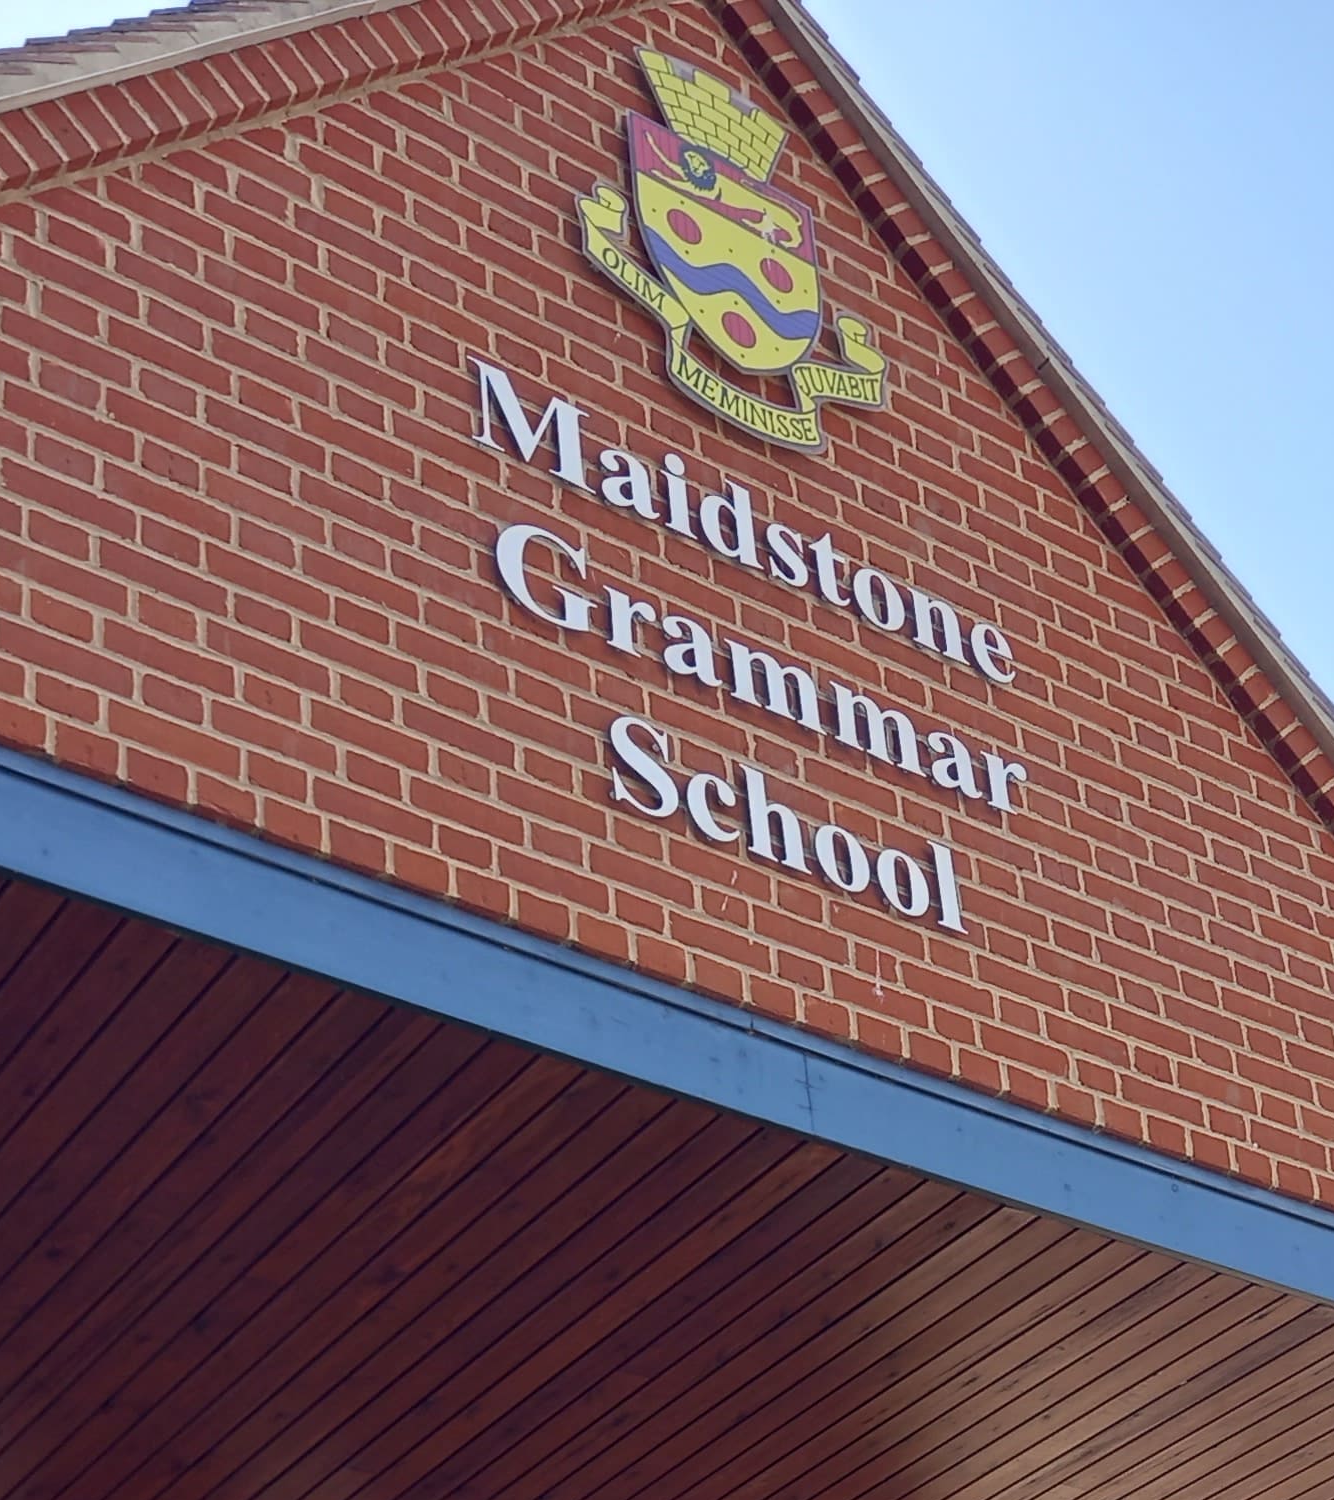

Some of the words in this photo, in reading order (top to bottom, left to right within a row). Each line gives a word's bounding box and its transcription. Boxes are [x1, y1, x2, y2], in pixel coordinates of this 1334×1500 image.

[601, 247, 666, 312] OLIM
[676, 352, 817, 442] MEMINISSE
[796, 366, 879, 402] JUVABIT
[467, 355, 1017, 684] Maidstone
[495, 523, 1027, 815] Grammar
[608, 715, 968, 934] School
